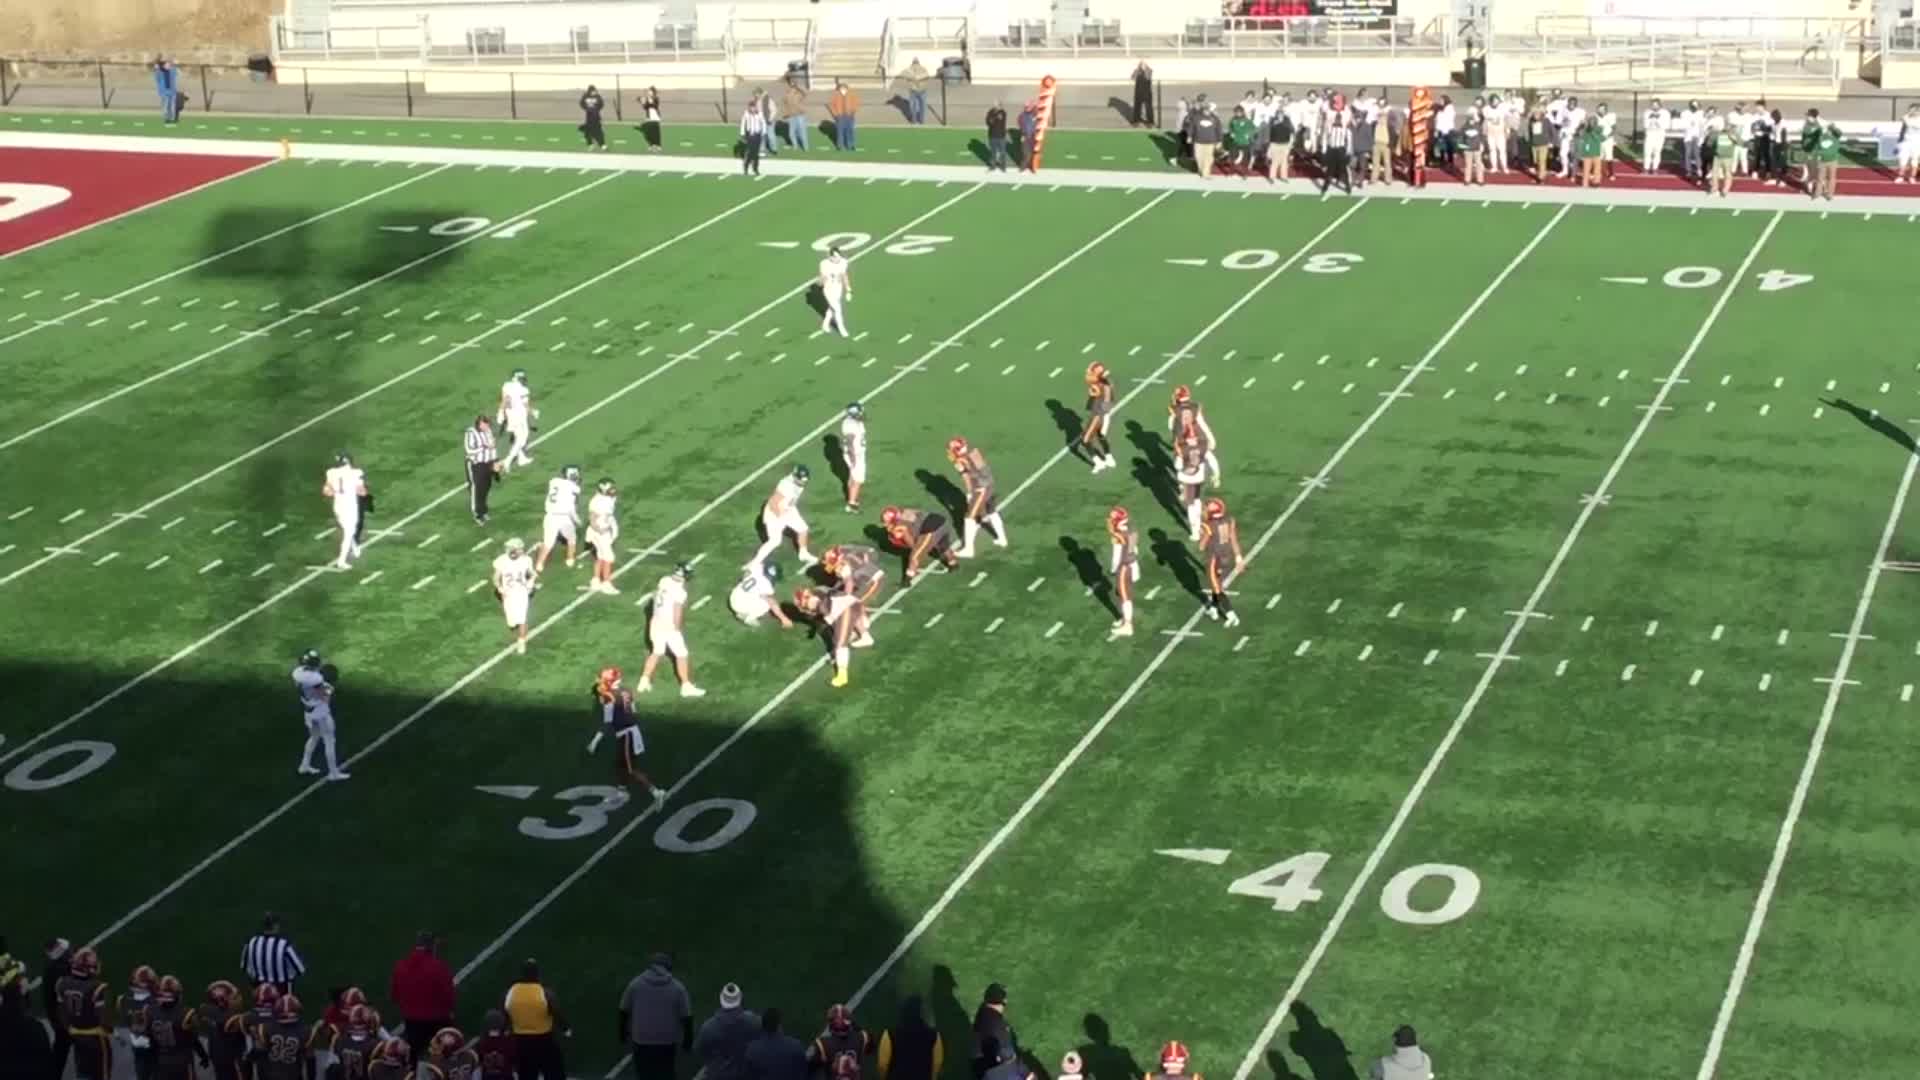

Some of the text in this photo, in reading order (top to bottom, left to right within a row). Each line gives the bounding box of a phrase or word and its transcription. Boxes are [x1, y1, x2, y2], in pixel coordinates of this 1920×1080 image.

[0, 733, 117, 790] 0
[518, 785, 757, 852] 30
[1227, 851, 1481, 924] 40
[270, 1034, 299, 1064] 32
